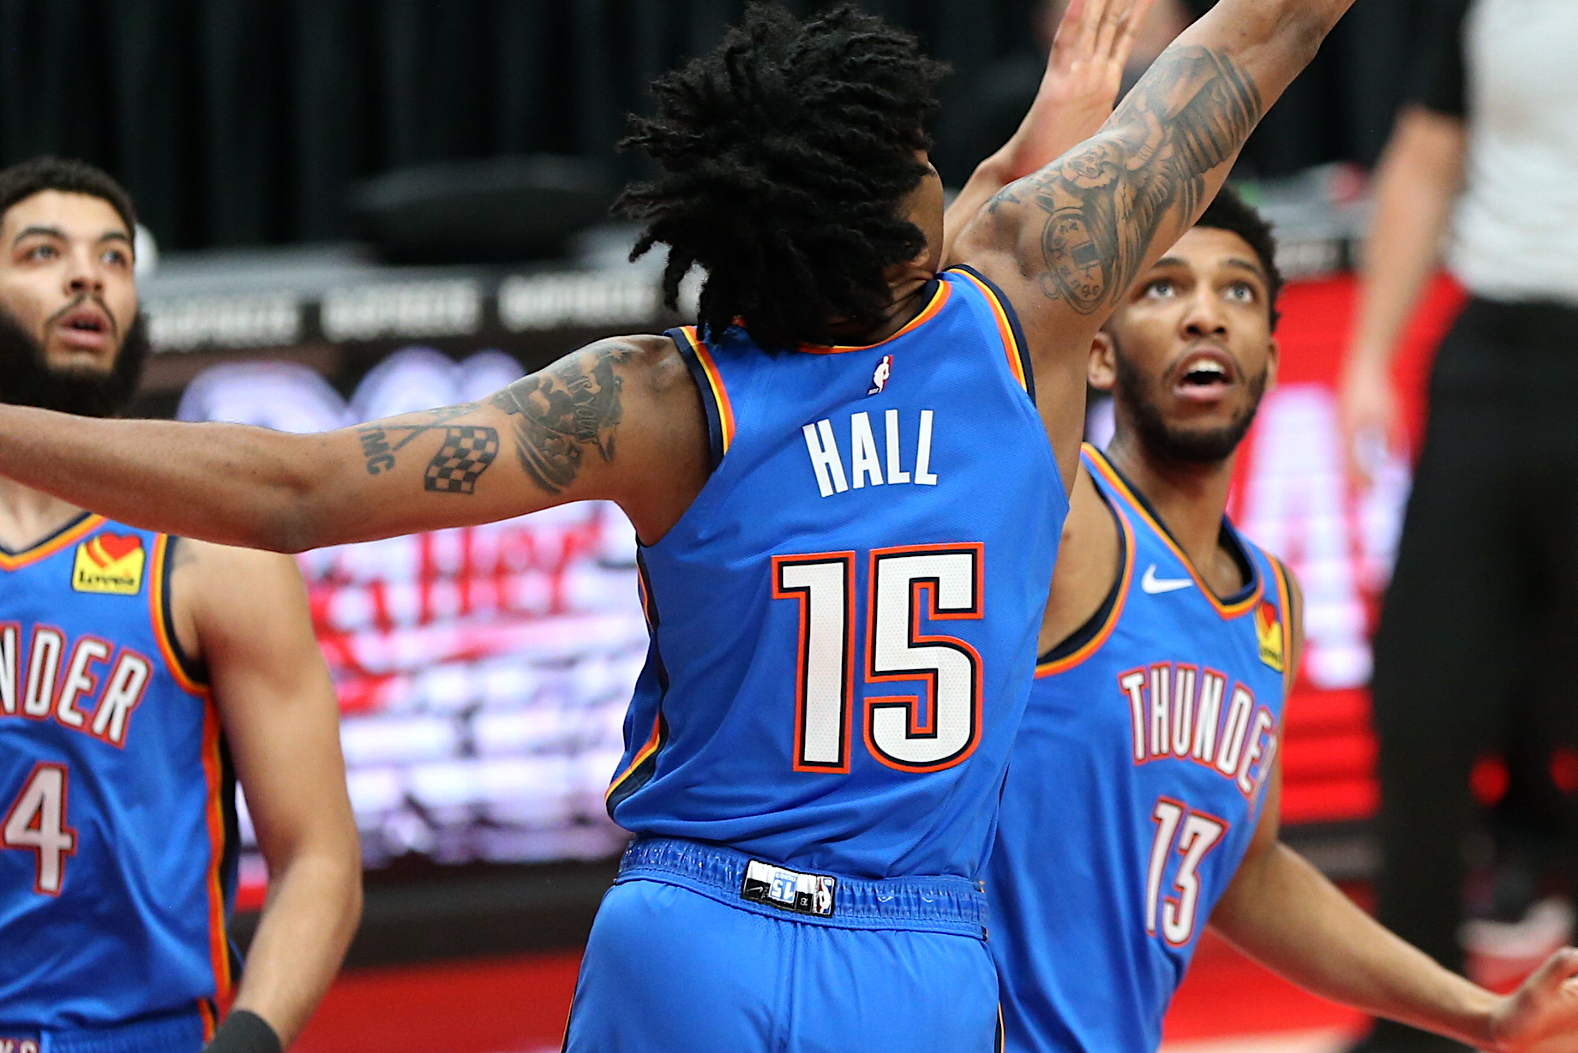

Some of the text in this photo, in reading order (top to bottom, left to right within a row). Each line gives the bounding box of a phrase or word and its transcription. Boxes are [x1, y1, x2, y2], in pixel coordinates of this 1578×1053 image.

[802, 408, 939, 499] HALL
[771, 542, 985, 774] 15
[1146, 796, 1231, 947] 13
